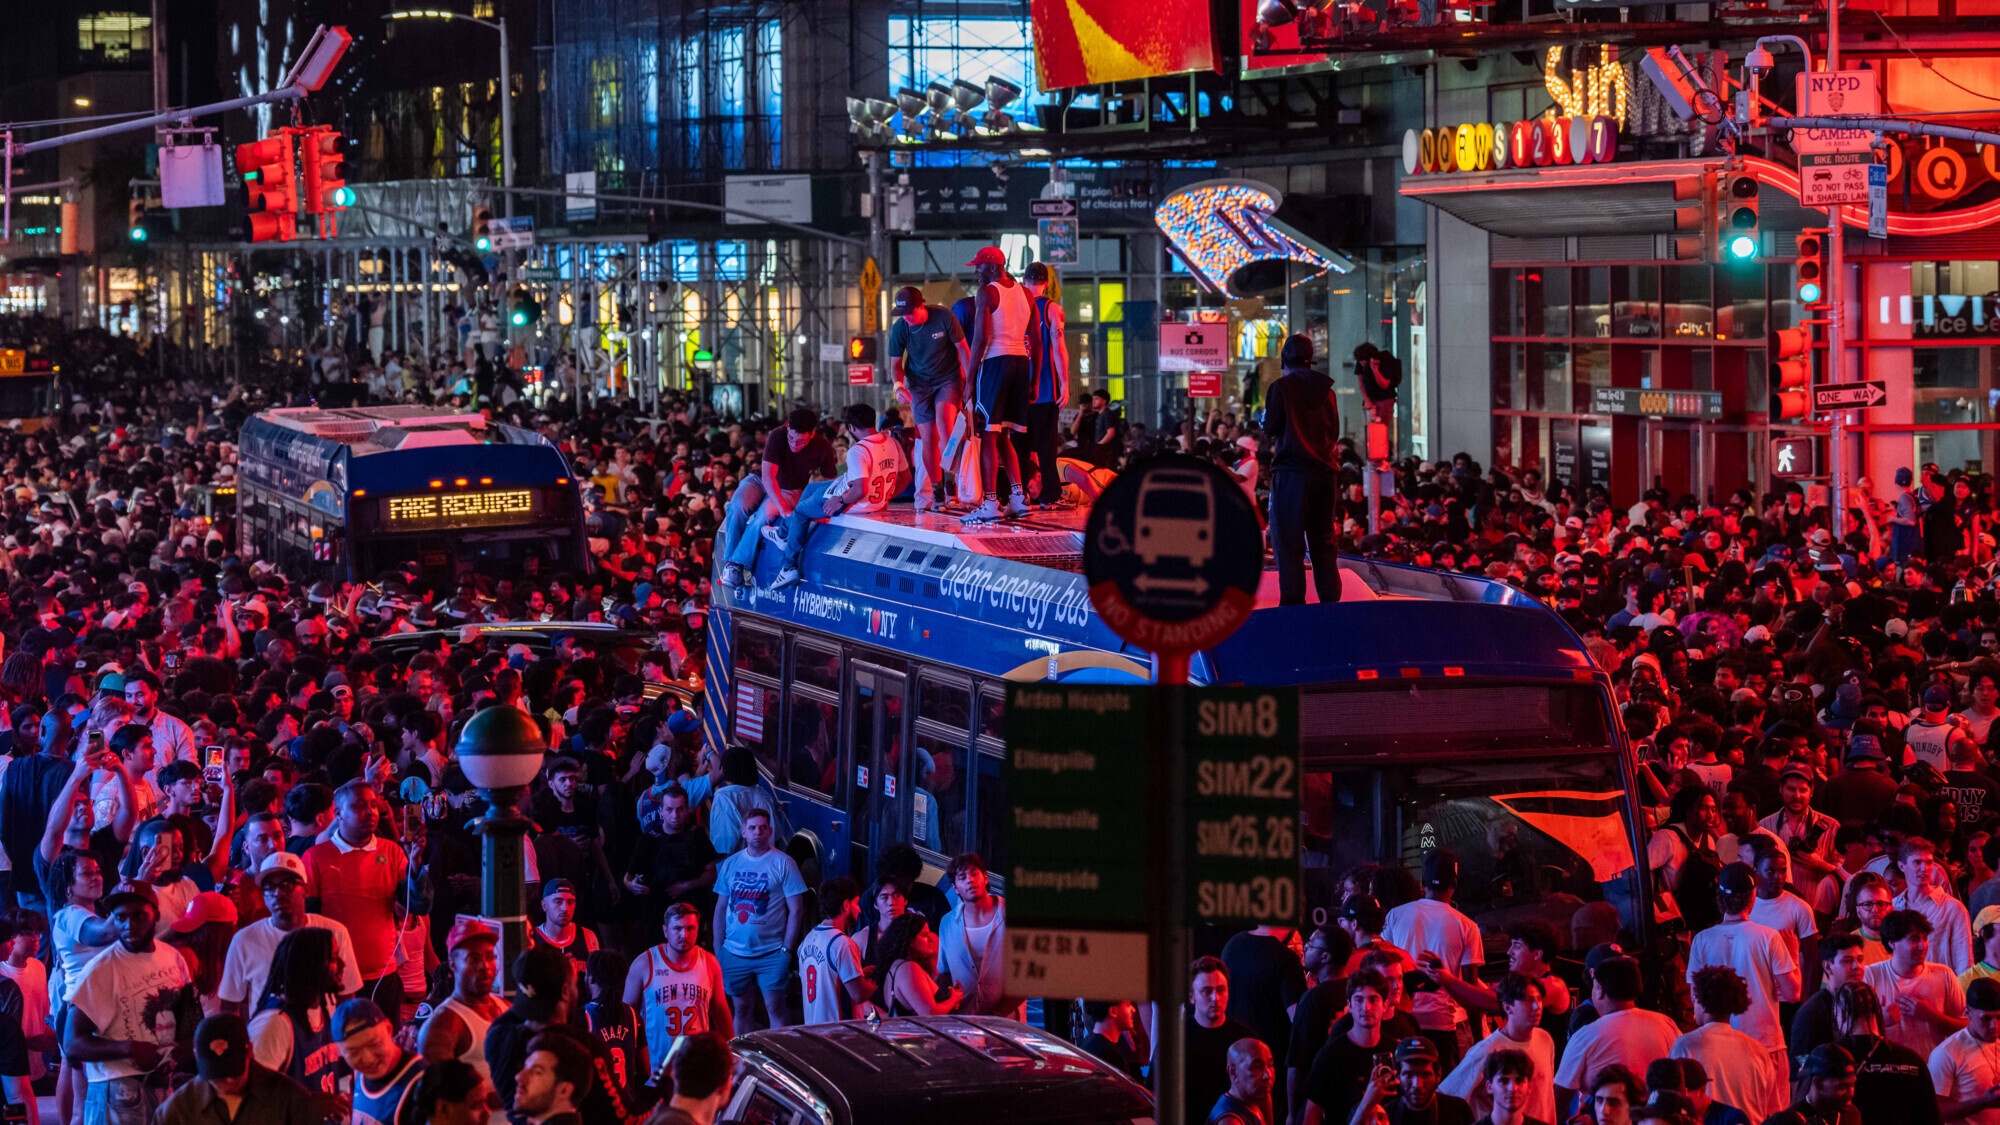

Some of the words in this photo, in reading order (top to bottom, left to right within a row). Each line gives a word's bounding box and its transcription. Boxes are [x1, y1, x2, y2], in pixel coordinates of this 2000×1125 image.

[1812, 76, 1860, 92] NYPD
[1422, 137, 1431, 163] N
[1440, 134, 1449, 157] Q
[1458, 134, 1467, 161] R
[1475, 135, 1486, 160] W
[1495, 130, 1504, 160] S
[1515, 131, 1522, 158] 1
[1533, 129, 1542, 158] 2
[1553, 123, 1562, 157] 3
[1594, 122, 1603, 154] 7
[1807, 128, 1867, 141] CAMERA
[1814, 156, 1832, 164] BIKE
[1834, 154, 1860, 163] ROUTE
[1928, 155, 1957, 190] Q
[1805, 194, 1814, 202] IN
[1817, 193, 1847, 202] SHARED
[1851, 191, 1869, 201] LAN
[1812, 183, 1823, 192] DO
[1826, 182, 1841, 191] NOT
[1844, 181, 1865, 190] PASS
[1081, 200, 1091, 210] of
[1679, 322, 1702, 334] City
[1170, 348, 1183, 356] BUS
[1185, 348, 1218, 356] CORRIDOR
[7, 357, 22, 369] BUS
[1819, 392, 1842, 403] ONE
[1853, 389, 1876, 401] WAY
[868, 471, 897, 505] 32
[390, 496, 438, 519] FARE
[441, 490, 531, 517] REQUIRED
[939, 555, 1062, 631] clean-energy
[1054, 577, 1090, 628] bus
[1103, 595, 1131, 626] NO
[1136, 601, 1240, 643] STANDING
[1068, 689, 1131, 715] Heights
[1014, 689, 1064, 710] Arden
[1198, 694, 1278, 738] SIM8
[1910, 742, 1944, 757] NUNOBY
[1197, 754, 1294, 799] SIM22
[1700, 780, 1724, 793] ART
[1943, 786, 1987, 806] DNY
[734, 871, 769, 883] NBA
[1014, 866, 1099, 893] Sunnyside
[733, 880, 769, 901] Finals
[1197, 875, 1295, 920] SIM30
[1012, 933, 1029, 952] W
[1032, 934, 1051, 955] 42
[1055, 934, 1073, 955] St
[1076, 935, 1089, 956] &
[1012, 959, 1022, 978] 7
[1026, 962, 1046, 979] Av
[655, 983, 679, 1006] NEW
[681, 982, 708, 1004] YORK
[806, 964, 817, 1004] 8
[665, 1005, 698, 1037] 32
[600, 1024, 630, 1042] HART
[610, 1047, 627, 1089] 3
